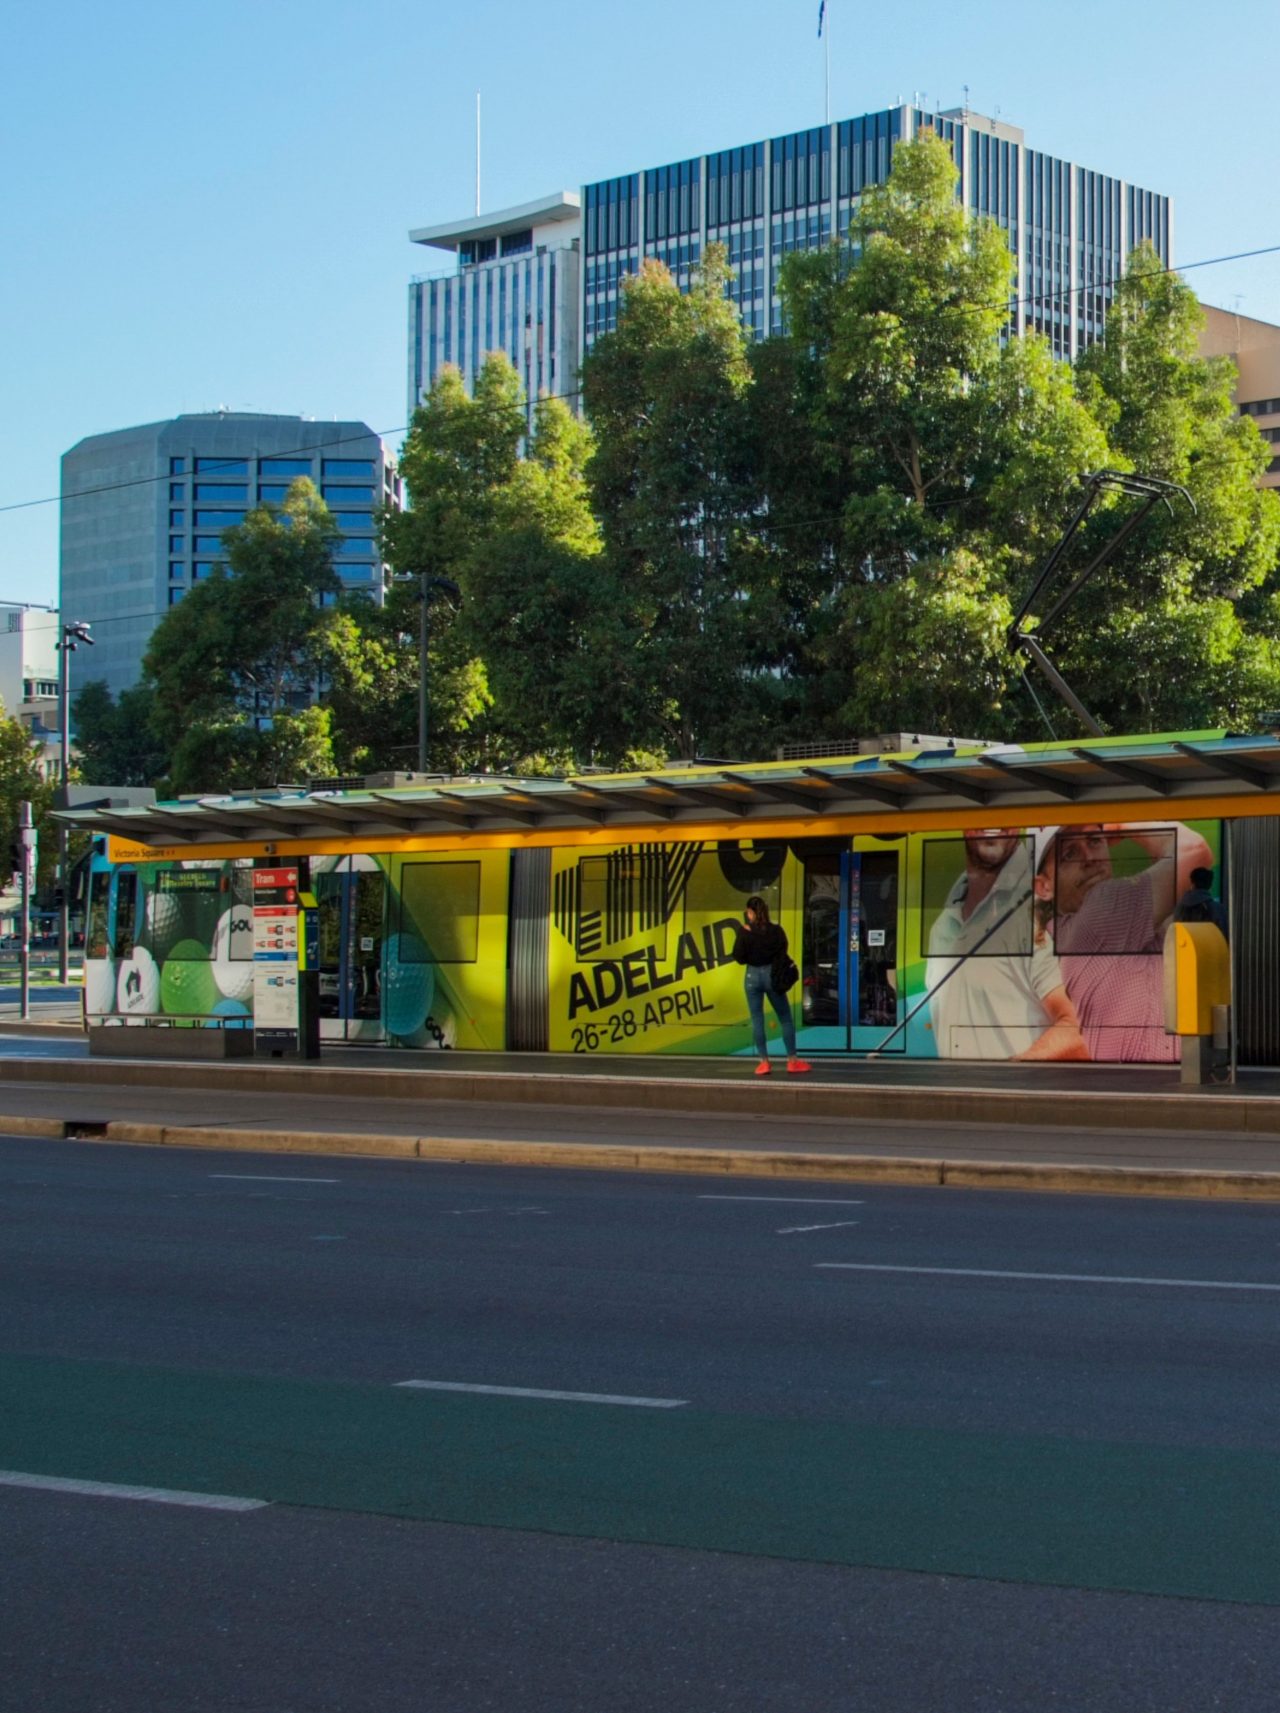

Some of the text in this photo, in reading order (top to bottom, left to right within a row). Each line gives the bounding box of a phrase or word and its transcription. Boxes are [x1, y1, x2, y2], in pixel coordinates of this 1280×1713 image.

[113, 848, 165, 859] Victoria Square
[255, 873, 275, 884] Tram
[568, 917, 746, 1020] ADELAID
[571, 985, 714, 1053] 26-28 APRIL
